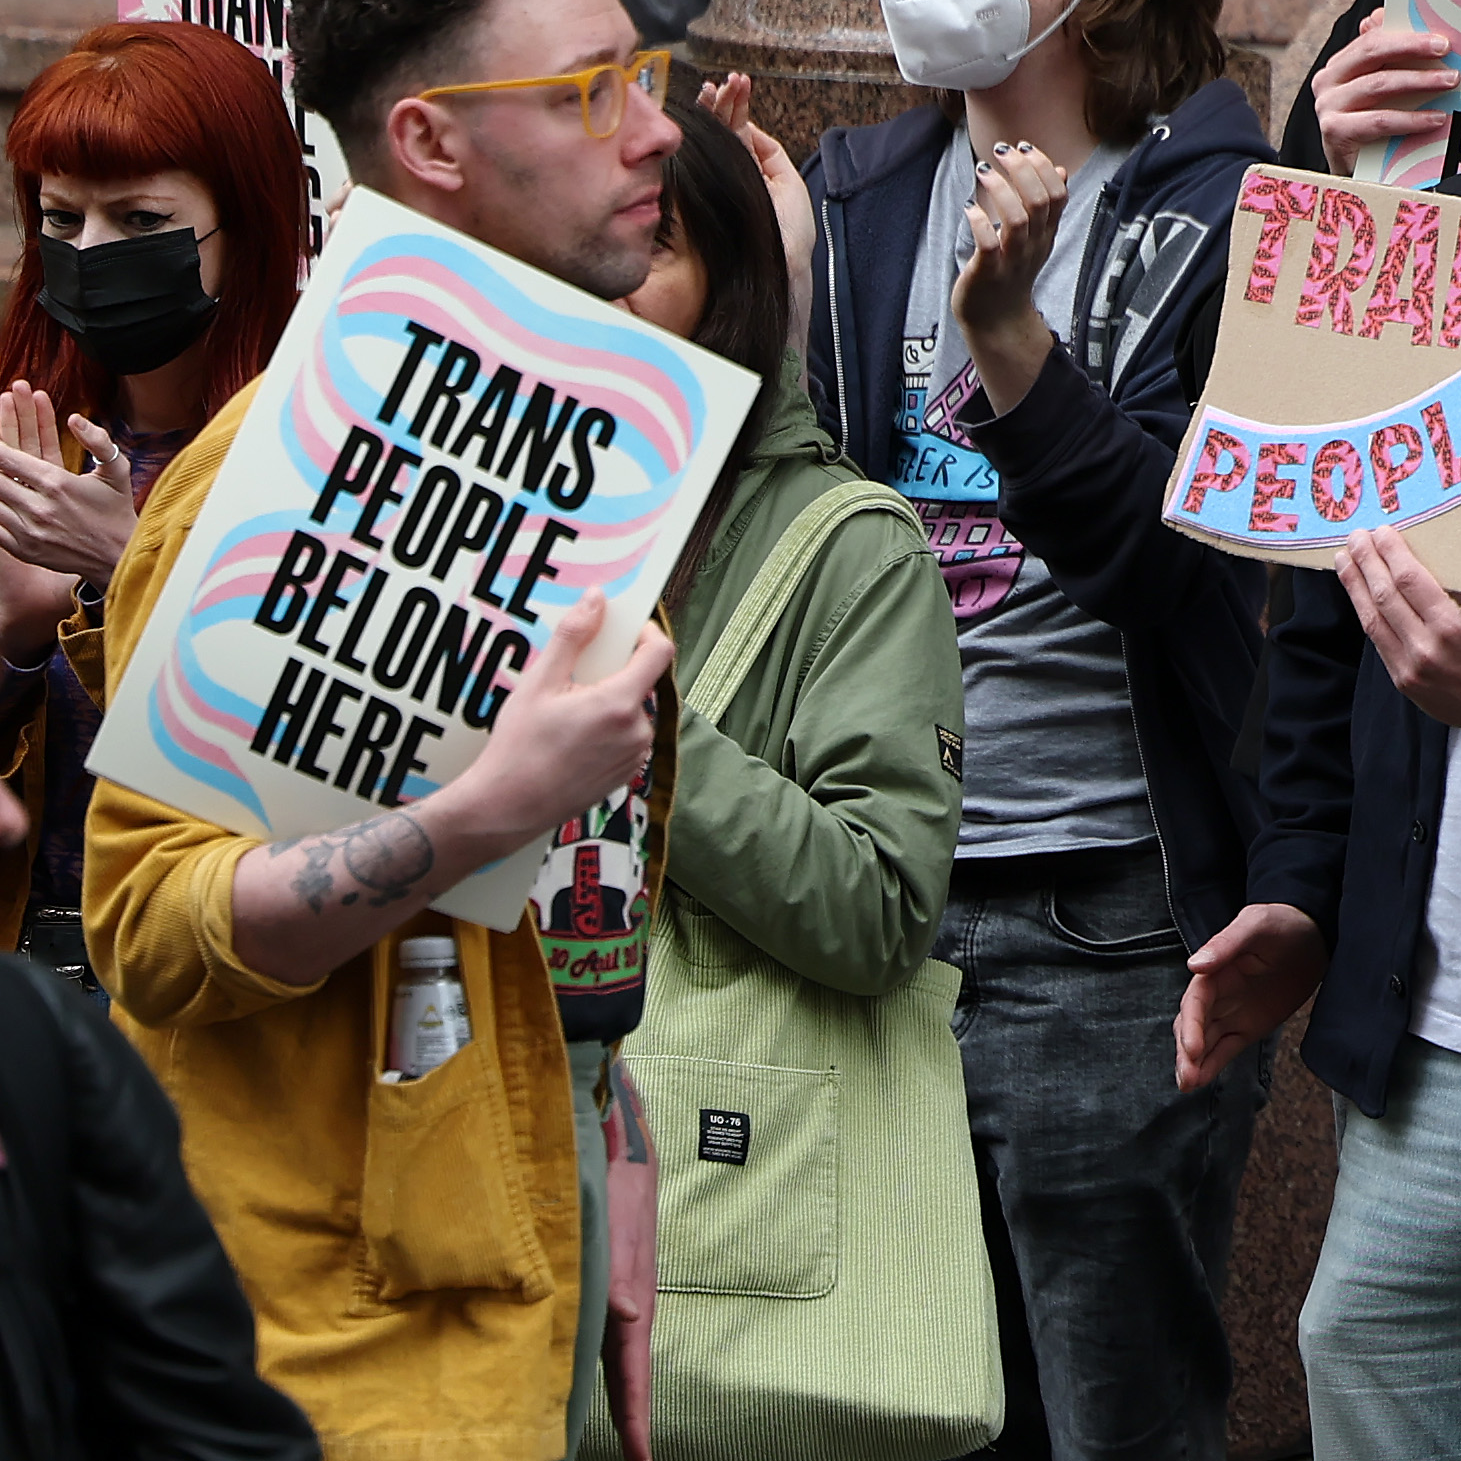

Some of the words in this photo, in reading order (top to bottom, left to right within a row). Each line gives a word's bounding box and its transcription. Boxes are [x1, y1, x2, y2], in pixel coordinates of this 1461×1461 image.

[376, 320, 616, 513] TRANS
[308, 426, 579, 625] PEOPLE
[253, 529, 531, 729] BELONG
[250, 658, 445, 808] HERE
